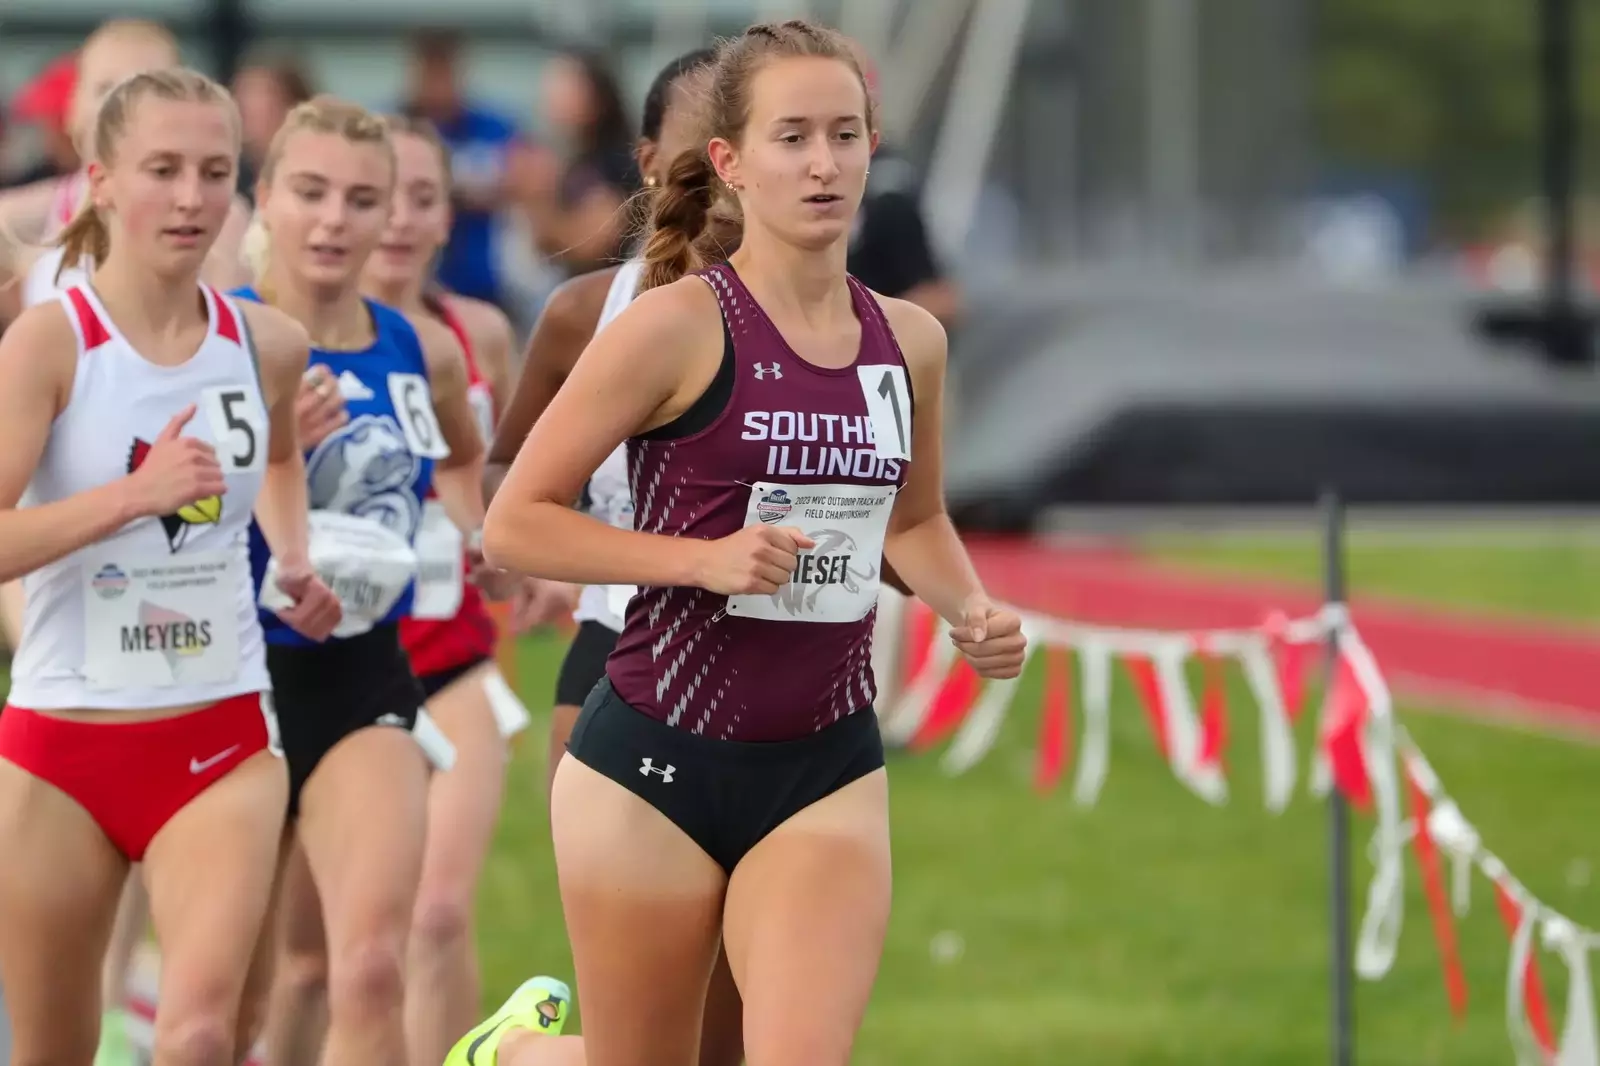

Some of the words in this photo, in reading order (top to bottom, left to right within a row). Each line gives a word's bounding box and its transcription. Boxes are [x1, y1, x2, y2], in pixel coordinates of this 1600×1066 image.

[220, 391, 256, 467] 5
[403, 381, 432, 450] 6
[741, 411, 876, 444] SOUTHE
[877, 371, 906, 454] 1
[766, 446, 901, 480] ILLINOIS
[795, 496, 810, 505] 2023
[811, 497, 826, 505] MVC
[828, 497, 856, 506] OUTDOOR
[856, 497, 875, 506] TRACK
[875, 497, 886, 505] AND
[804, 509, 823, 518] FIELD
[825, 510, 871, 519] CHAMPIONSHIPS
[793, 555, 851, 584] IESET
[120, 620, 212, 652] MEYERS
